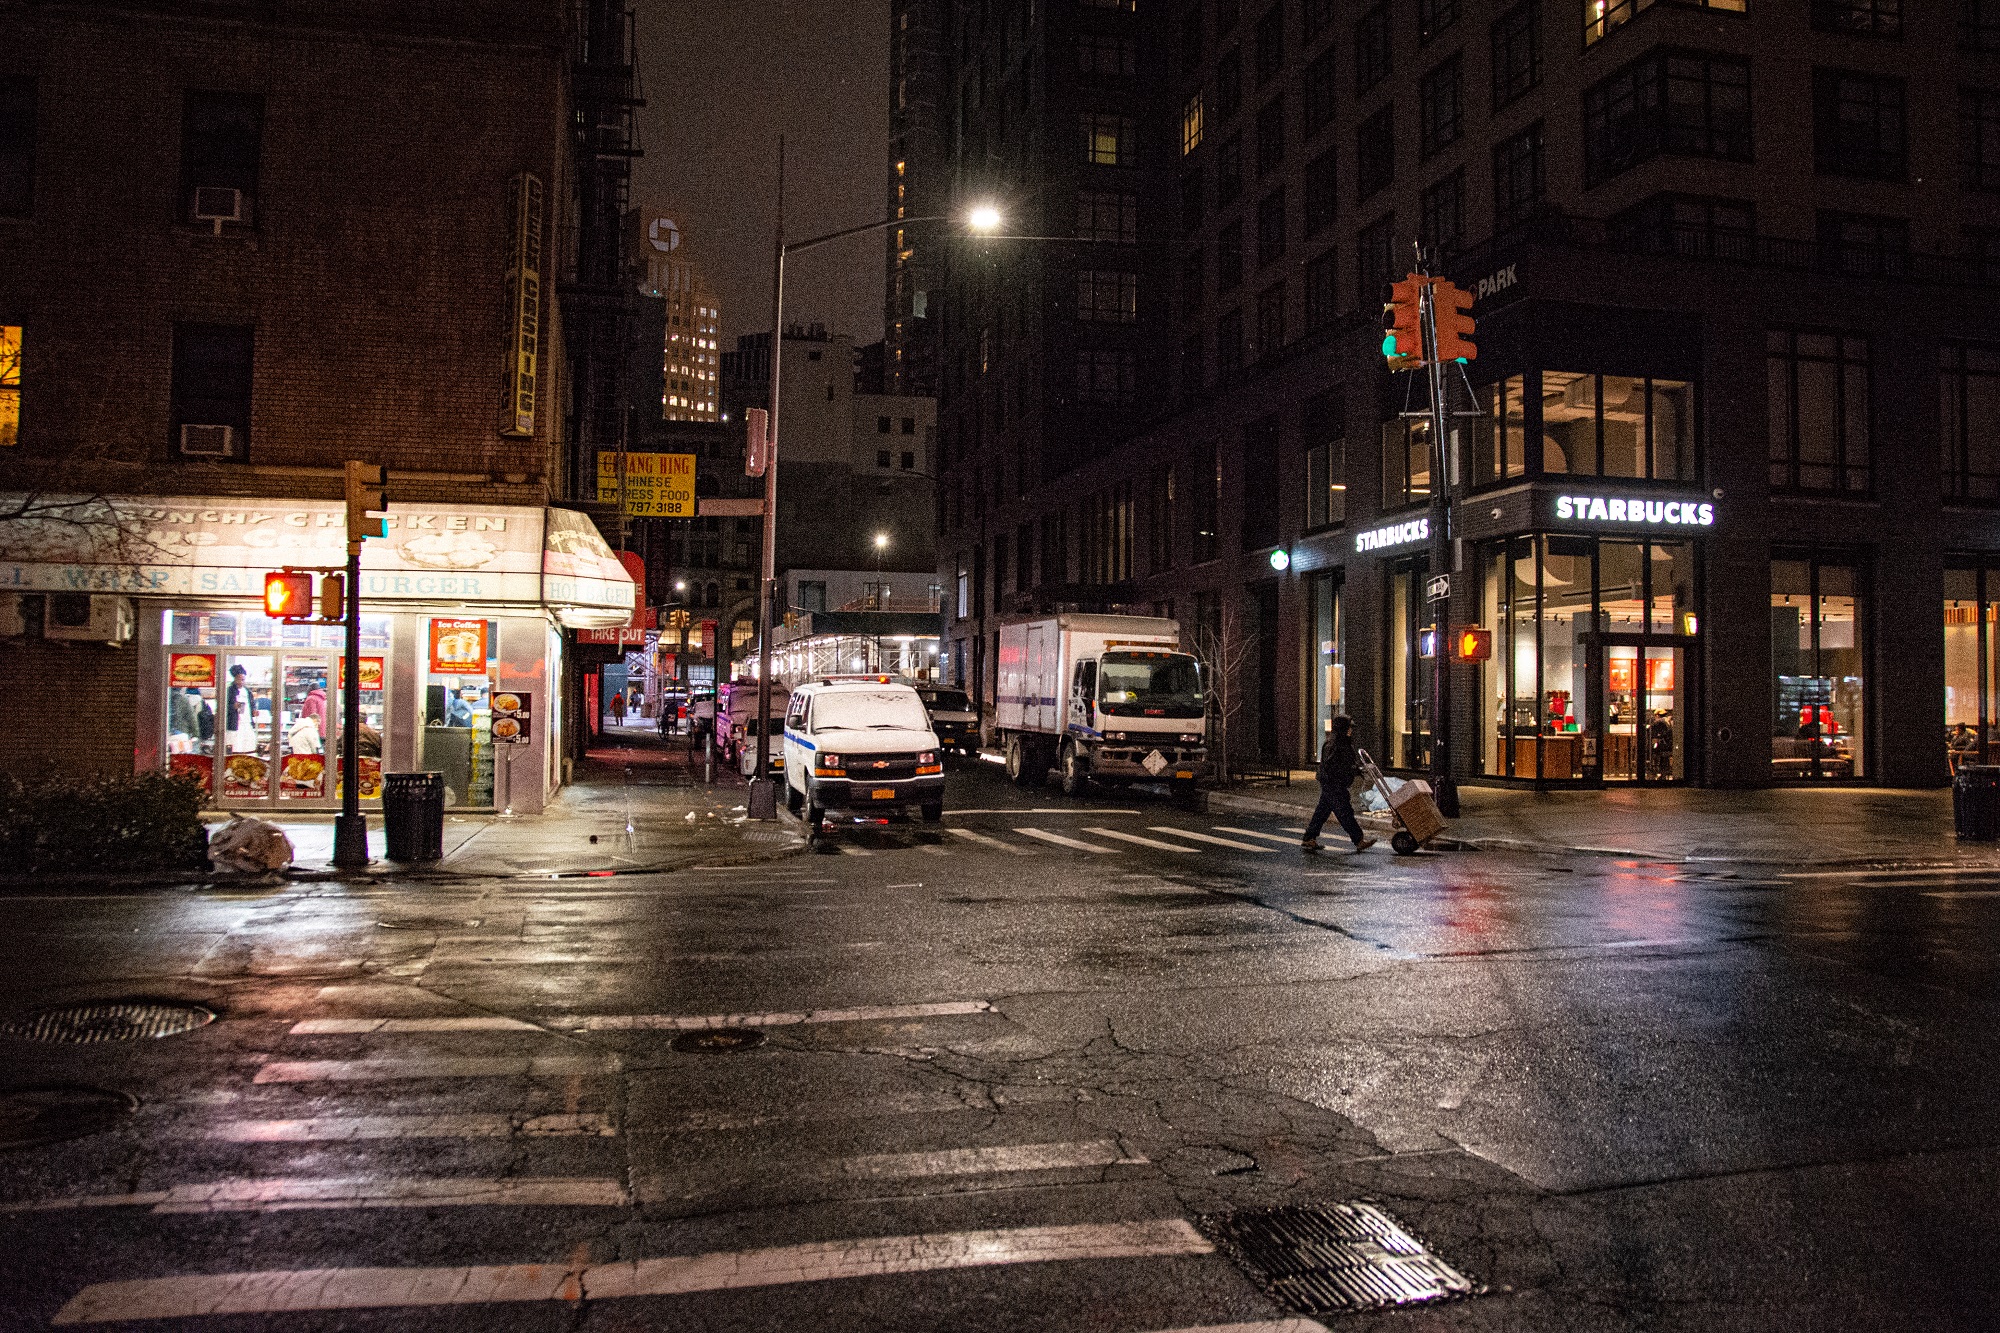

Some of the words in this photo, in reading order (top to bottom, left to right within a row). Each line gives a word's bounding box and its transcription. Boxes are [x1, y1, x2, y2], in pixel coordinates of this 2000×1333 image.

[525, 178, 542, 271] CHECK
[1478, 262, 1518, 301] PARK
[519, 277, 538, 412] CASHING
[604, 455, 653, 475] CANG
[659, 456, 690, 474] HING
[627, 476, 672, 488] HINESE
[602, 488, 654, 500] EXRESS
[660, 490, 690, 501] FOOD
[629, 502, 682, 513] 797-3188
[1555, 495, 1714, 526] STARBUCKS
[283, 512, 508, 532] CHCKEN
[1355, 517, 1429, 553] STARBUCKS
[360, 576, 482, 595] URGER
[549, 581, 579, 600] HOT
[586, 585, 633, 605] BAGEL
[453, 621, 481, 629] Coffee
[591, 627, 615, 640] TAKE
[620, 628, 643, 640] OUT
